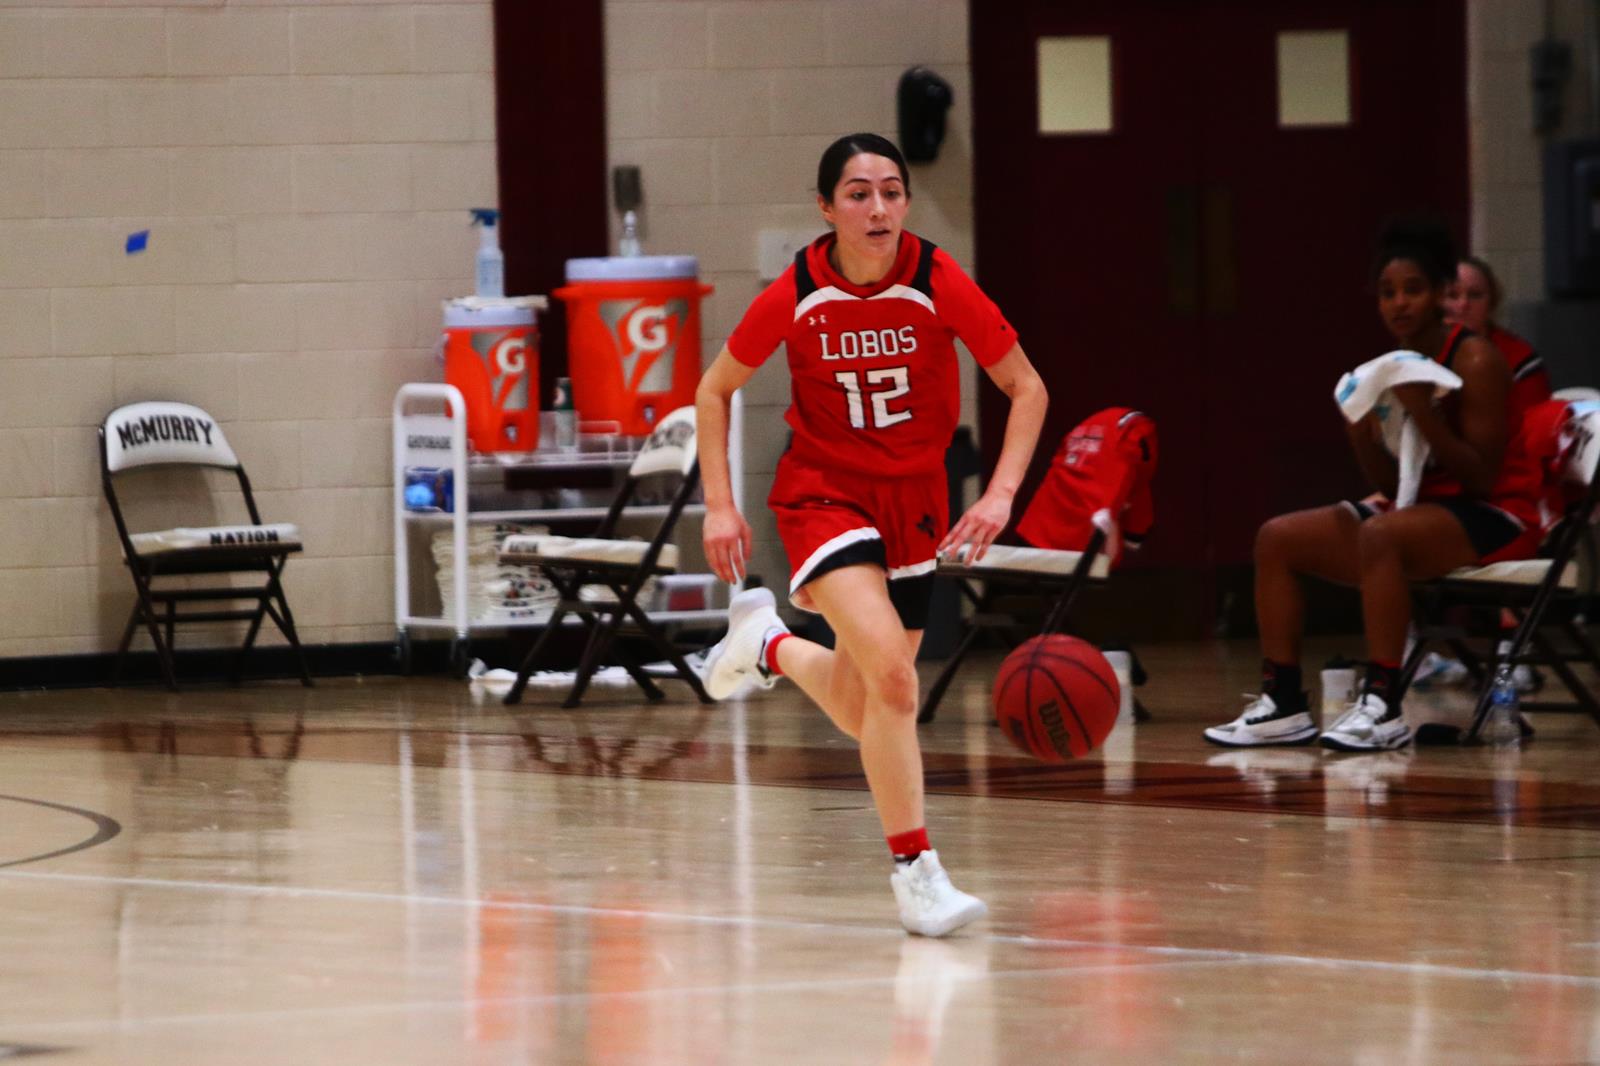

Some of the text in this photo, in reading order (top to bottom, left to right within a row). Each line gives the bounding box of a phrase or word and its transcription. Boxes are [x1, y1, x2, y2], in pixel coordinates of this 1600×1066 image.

[627, 306, 667, 350] G
[819, 325, 917, 360] LOBOS
[496, 338, 525, 373] G
[834, 366, 913, 429] 12
[117, 414, 213, 450] McMURRY
[210, 530, 279, 545] NATION
